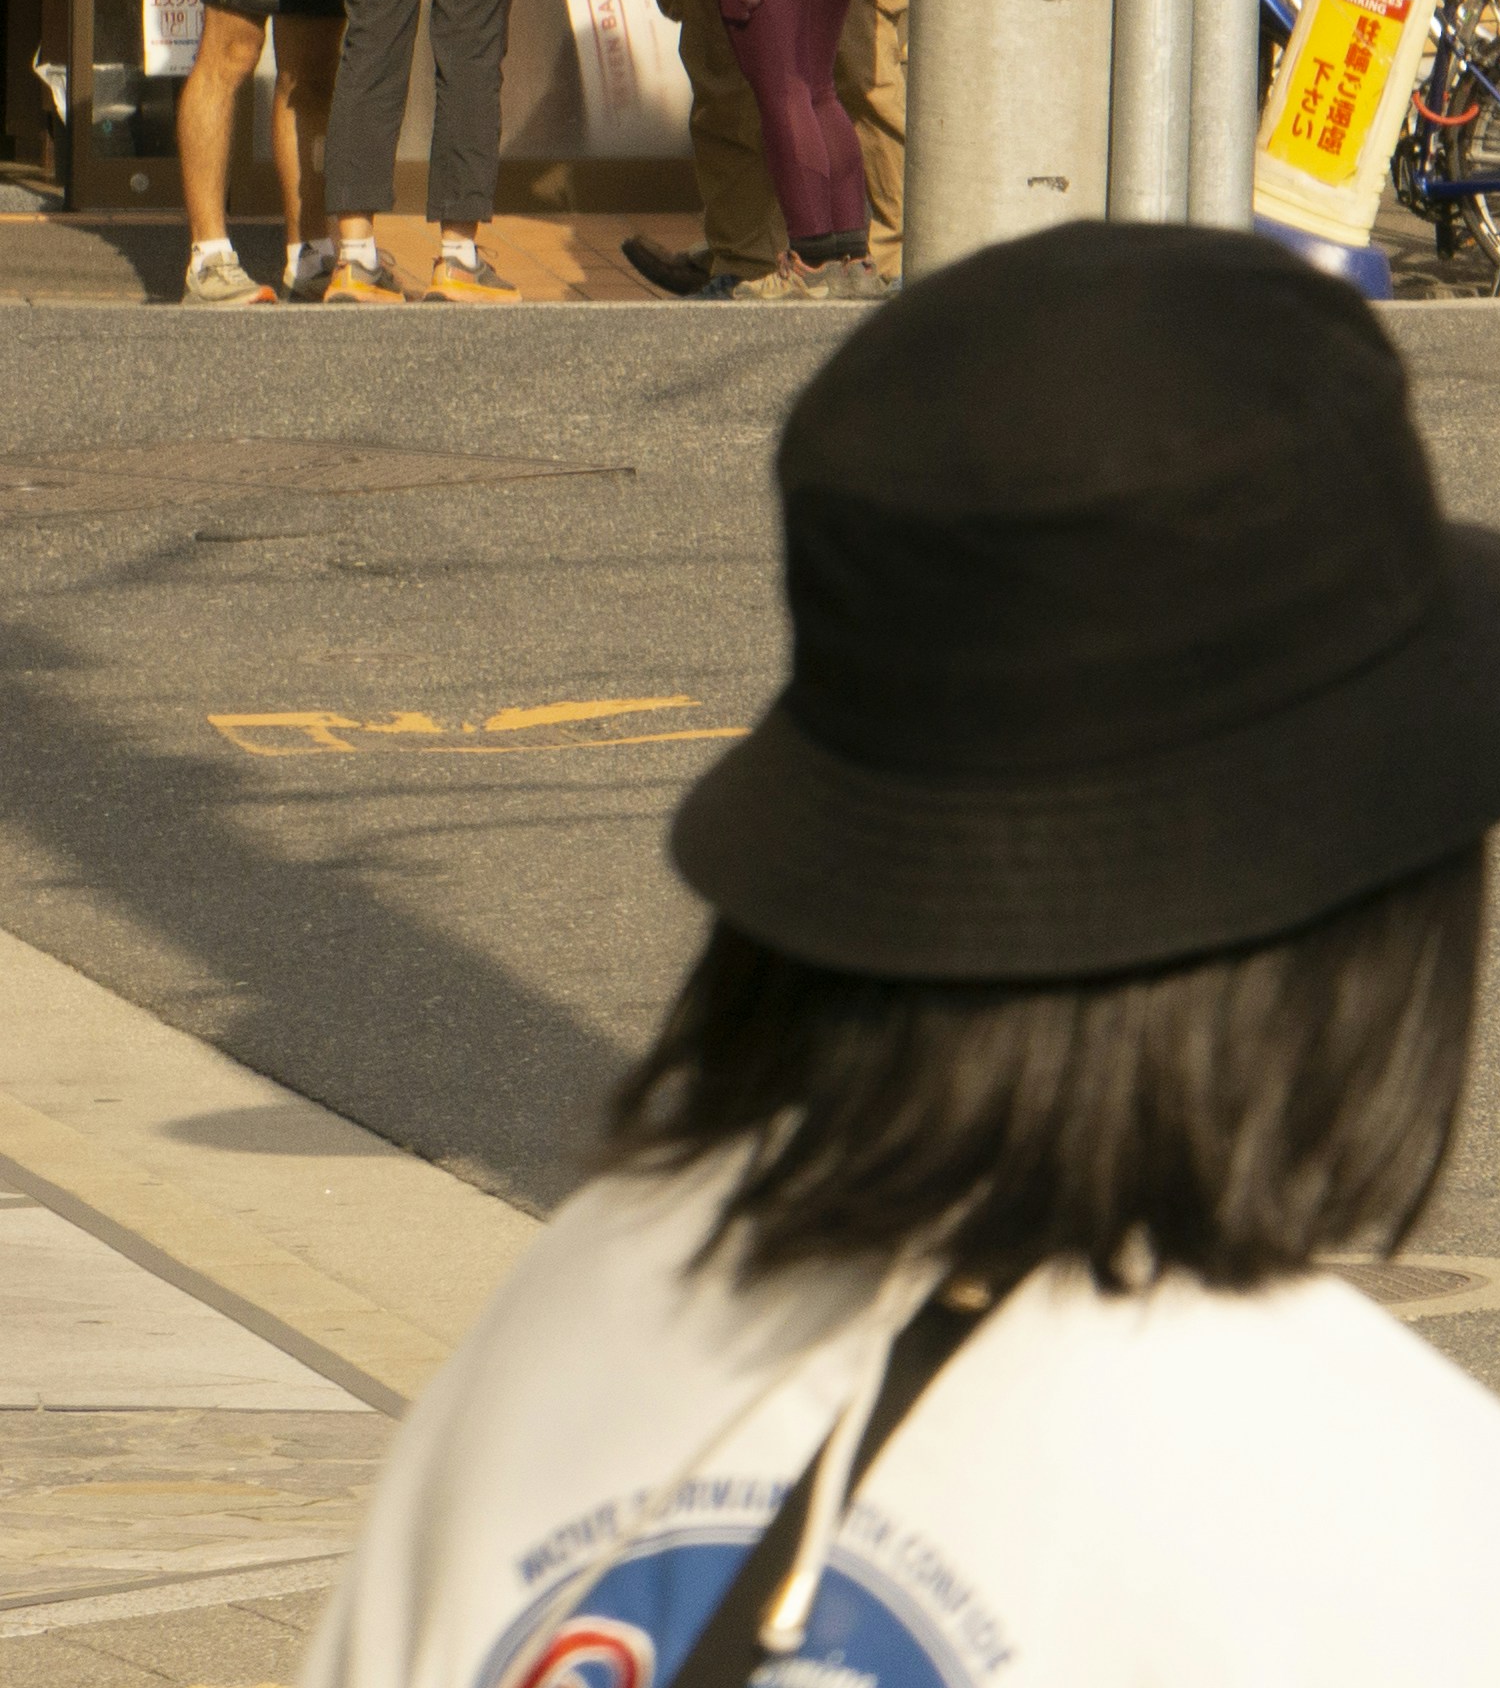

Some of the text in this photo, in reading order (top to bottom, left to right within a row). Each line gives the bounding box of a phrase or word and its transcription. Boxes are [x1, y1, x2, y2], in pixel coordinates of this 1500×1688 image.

[1290, 55, 1336, 141] 下さい
[1316, 14, 1382, 156] 駐輪ご遠慮
